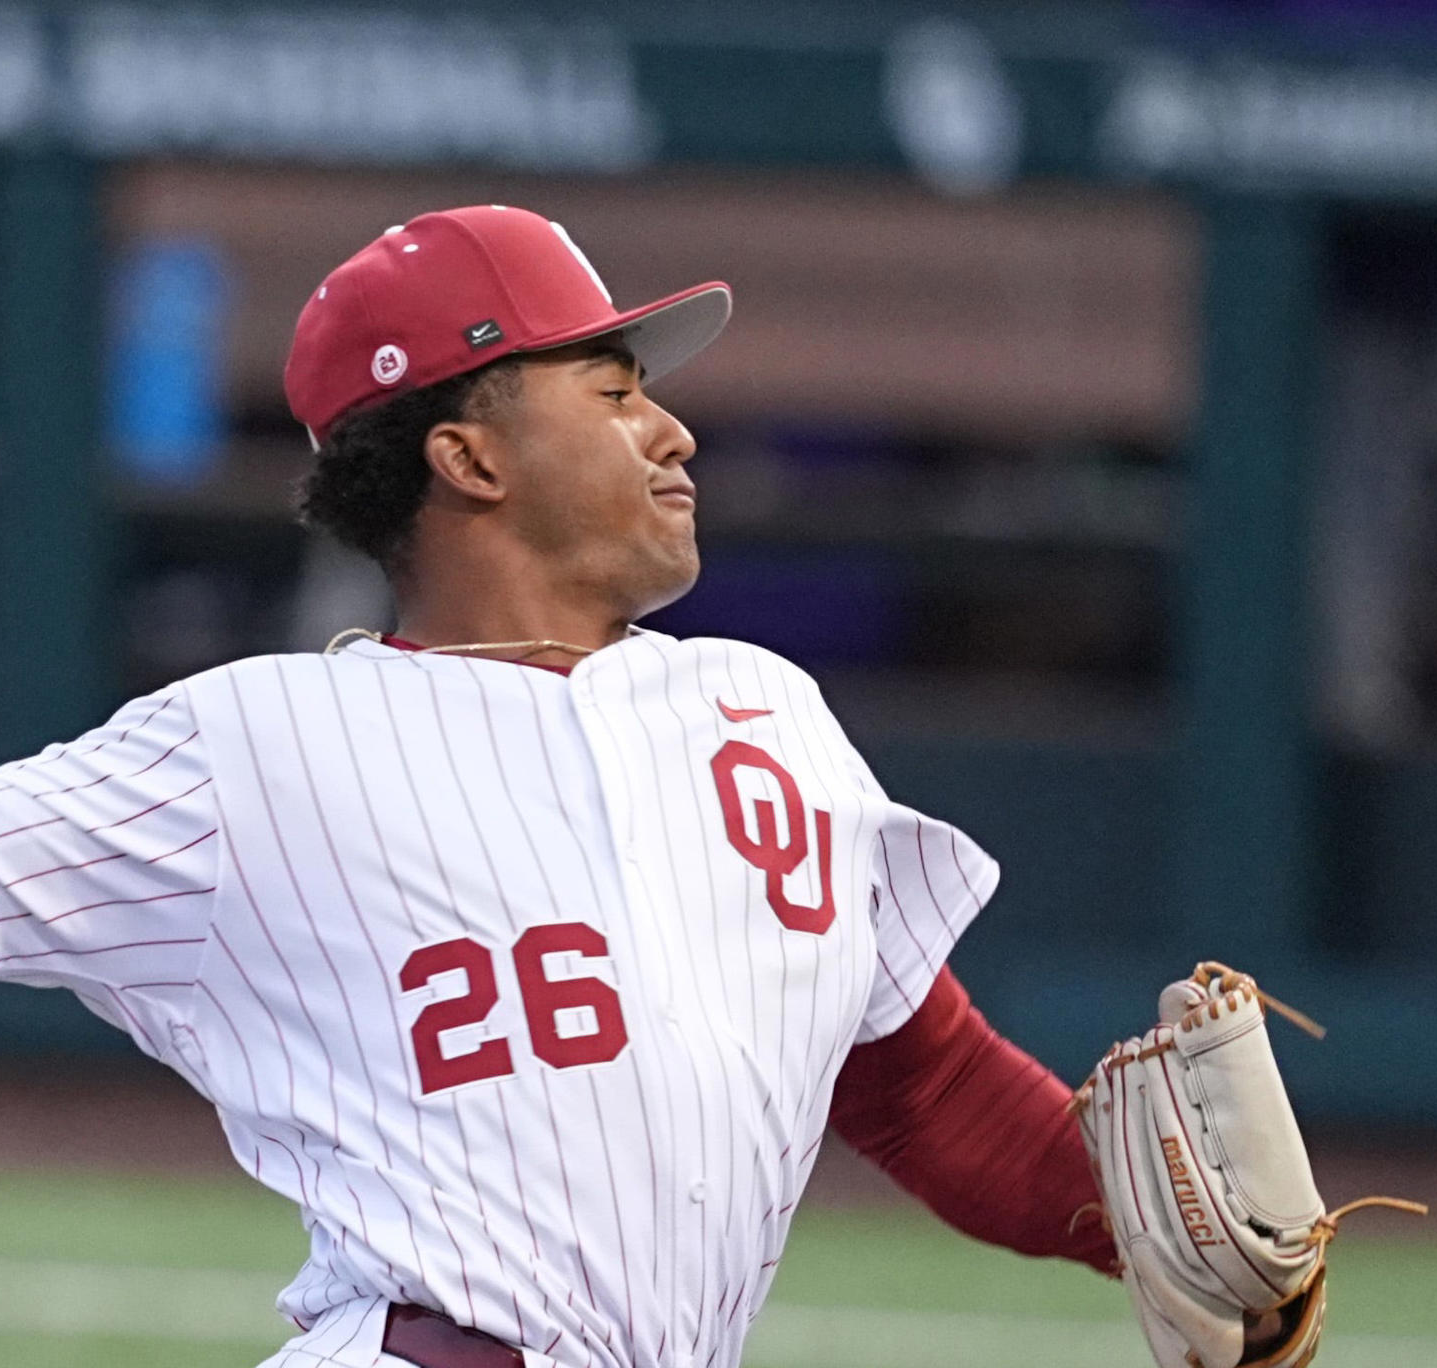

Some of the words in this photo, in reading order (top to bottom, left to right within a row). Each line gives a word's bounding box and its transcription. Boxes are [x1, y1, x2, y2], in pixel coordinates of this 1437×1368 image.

[709, 738, 837, 936] OU
[398, 920, 630, 1097] 26
[1162, 1136, 1226, 1246] marucci
